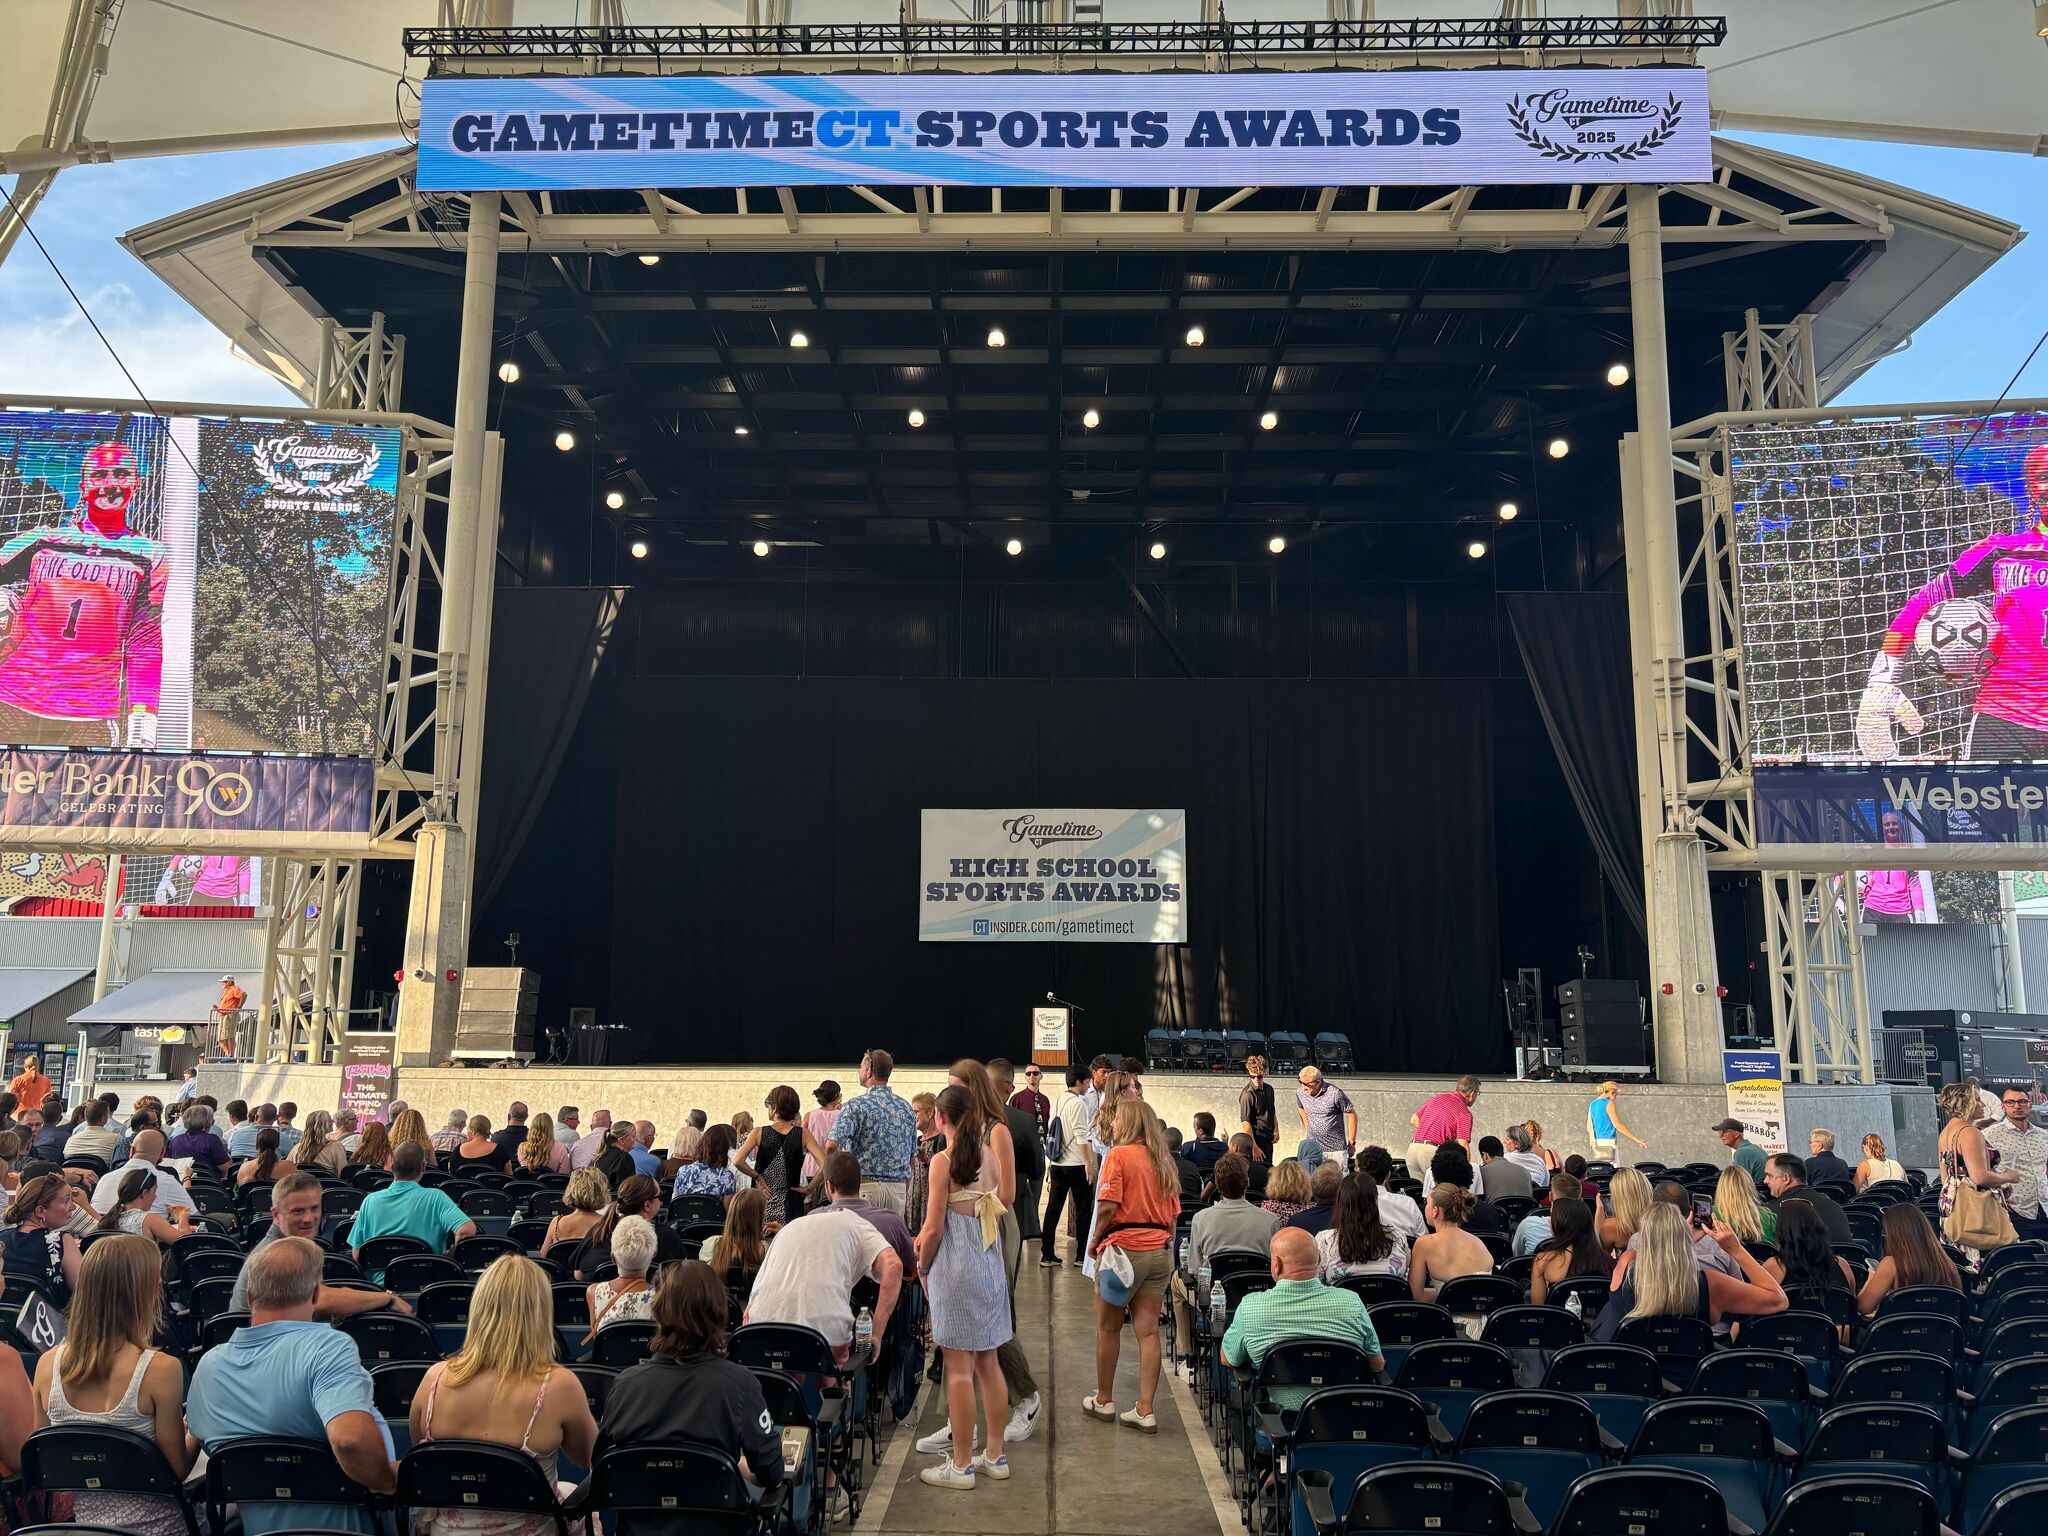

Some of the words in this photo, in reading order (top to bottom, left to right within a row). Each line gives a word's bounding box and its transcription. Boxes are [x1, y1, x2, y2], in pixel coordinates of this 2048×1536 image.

[1526, 89, 1659, 123] Gametime
[452, 110, 900, 152] GAMETIMECT
[916, 110, 1169, 149] SPORTS
[1185, 108, 1462, 147] AWARDS
[1569, 118, 1581, 126] CT
[1576, 132, 1616, 143] 2025
[268, 436, 364, 462] Gametime
[302, 471, 330, 481] 2025
[264, 500, 309, 511] SPORTS
[313, 502, 360, 513] AWARDS
[72, 562, 100, 582] OLD
[62, 598, 83, 640] 1
[63, 763, 164, 798] Bank
[177, 761, 253, 816] 90
[1883, 776, 2048, 811] Webste
[60, 802, 164, 814] CELEBRATING
[1003, 814, 1102, 843] Gametime
[1034, 838, 1043, 846] CT
[950, 858, 1029, 878] HIGH
[1036, 858, 1157, 878] SCHOOL
[926, 882, 1045, 902] SPORTS
[1051, 882, 1181, 902] AWARDS
[134, 1027, 164, 1042] tasty
[342, 1092, 388, 1100] ULTIMATE
[1728, 1084, 1781, 1093] Congratulations!
[347, 1100, 381, 1108] TYPING
[1743, 1122, 1776, 1140] RRARO'S
